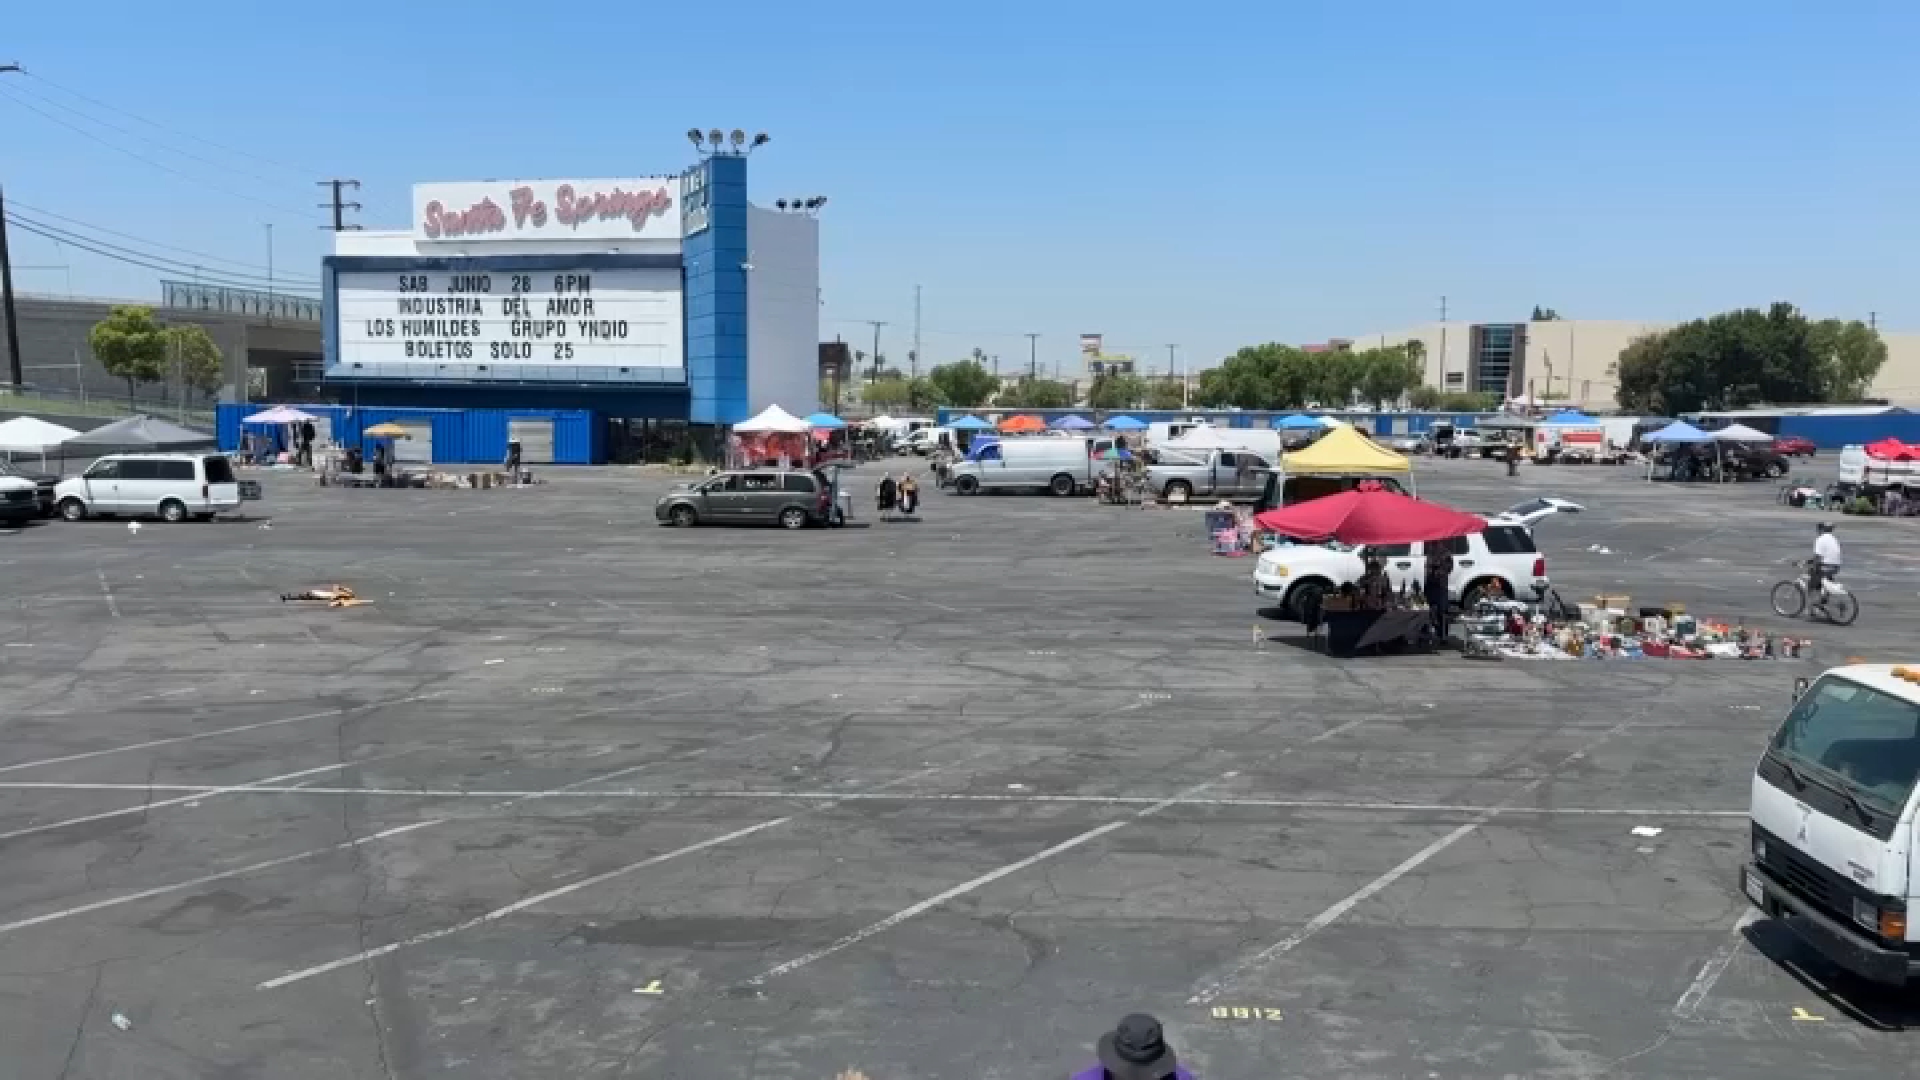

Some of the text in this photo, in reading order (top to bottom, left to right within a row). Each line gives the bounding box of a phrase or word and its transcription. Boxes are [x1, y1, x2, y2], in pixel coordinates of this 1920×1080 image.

[424, 197, 506, 238] Santa
[510, 186, 548, 229] Fe
[555, 184, 672, 232] Springs
[399, 275, 590, 294] SAB JUNIO 28 6PM
[397, 297, 595, 317] INDUSTRIA DEL AMOR
[366, 319, 628, 338] LOS HUMILDES GRUPO YNDIO
[405, 340, 574, 359] BOLETOS SOLO 25
